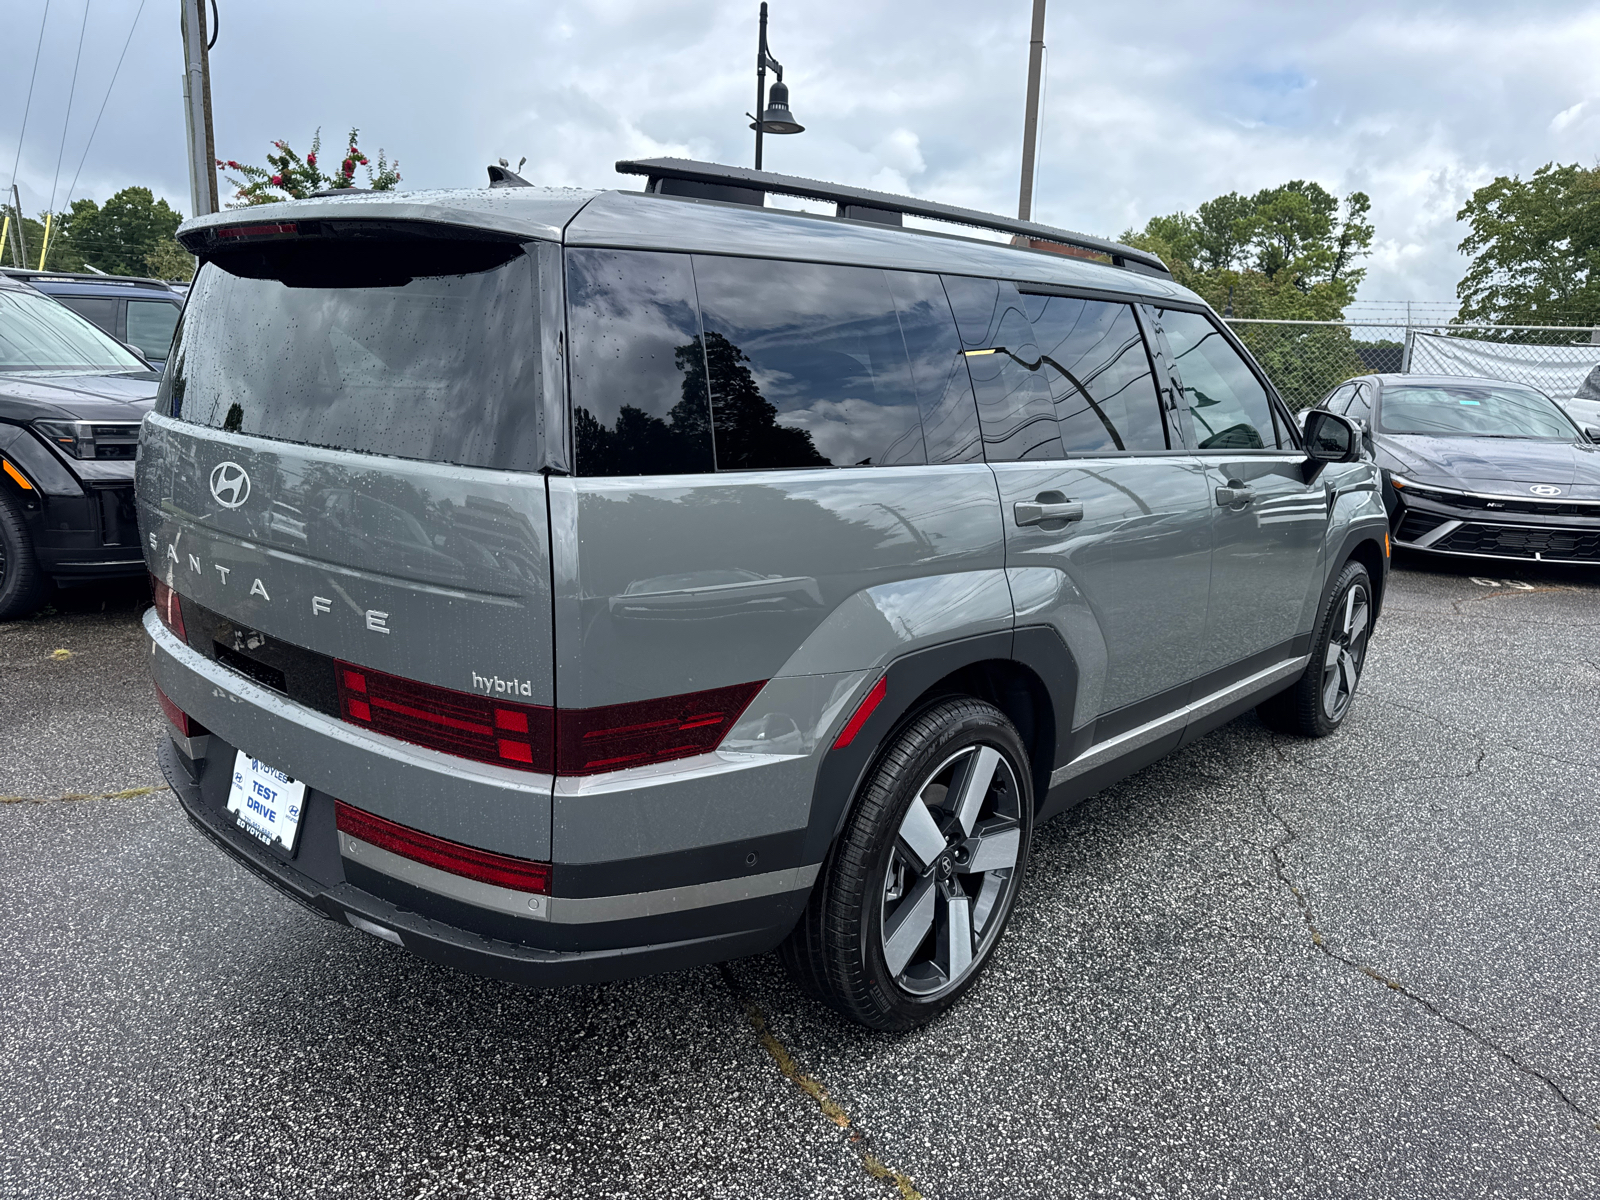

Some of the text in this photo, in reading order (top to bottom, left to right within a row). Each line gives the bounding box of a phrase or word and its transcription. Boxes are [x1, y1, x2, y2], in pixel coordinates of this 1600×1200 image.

[149, 532, 390, 634] SANTA FE
[472, 671, 532, 697] hybrid
[260, 761, 288, 784] VOYLES
[253, 780, 278, 803] TEST
[247, 796, 277, 823] DRIVE
[236, 818, 247, 829] ED
[246, 824, 271, 846] VOYLES
